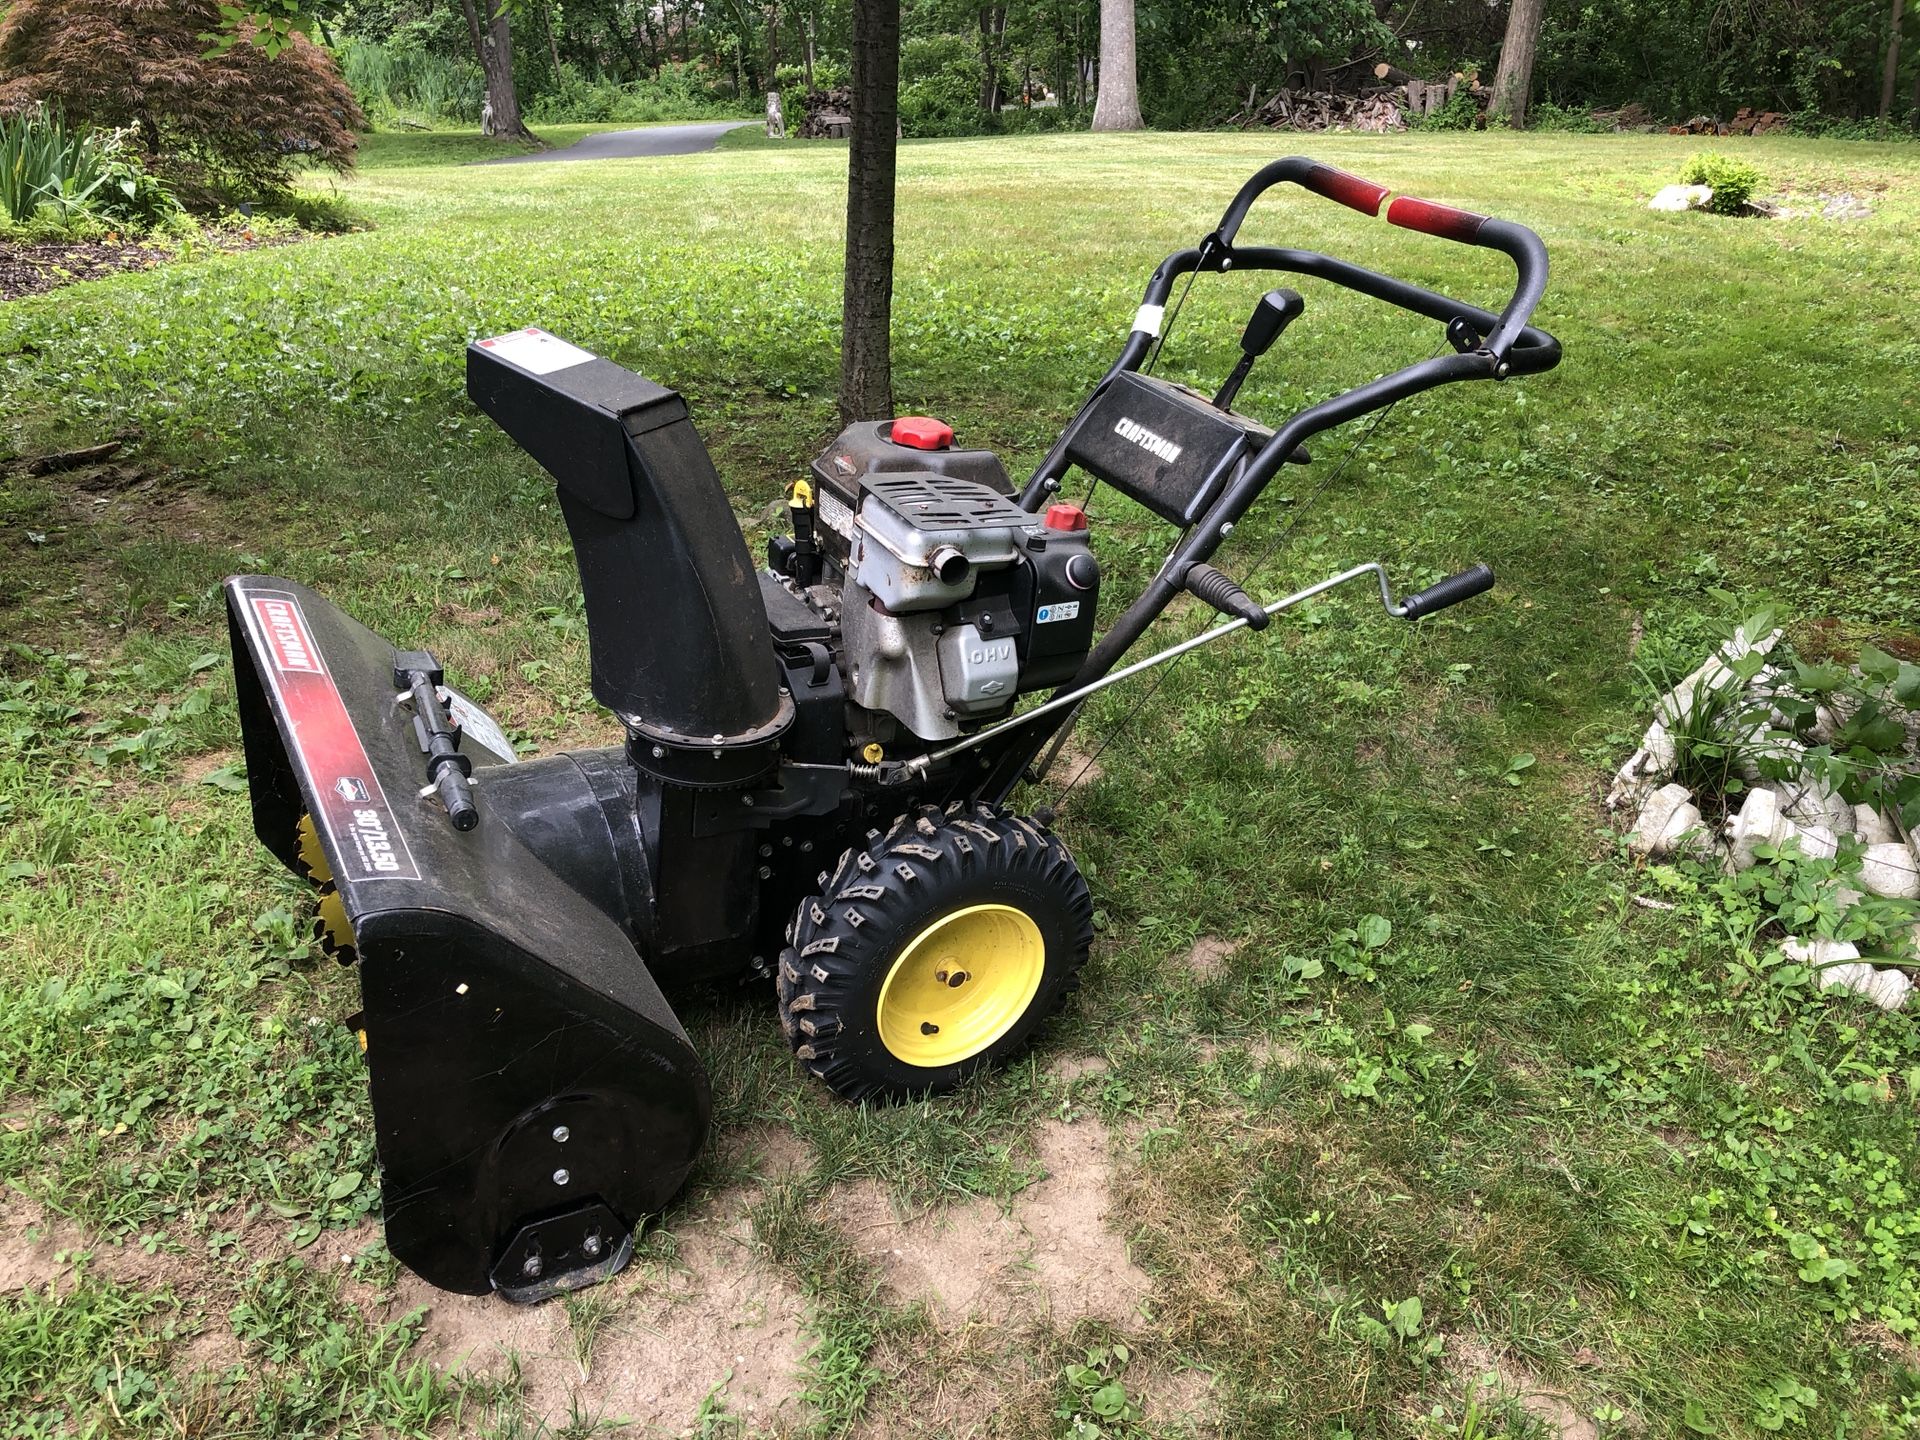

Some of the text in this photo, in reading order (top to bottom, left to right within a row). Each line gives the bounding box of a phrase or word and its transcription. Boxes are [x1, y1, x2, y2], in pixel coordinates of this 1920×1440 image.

[1114, 417, 1183, 464] CRAFTSMAN
[265, 603, 311, 667] CRAFTSMAN
[971, 645, 1010, 664] OHV
